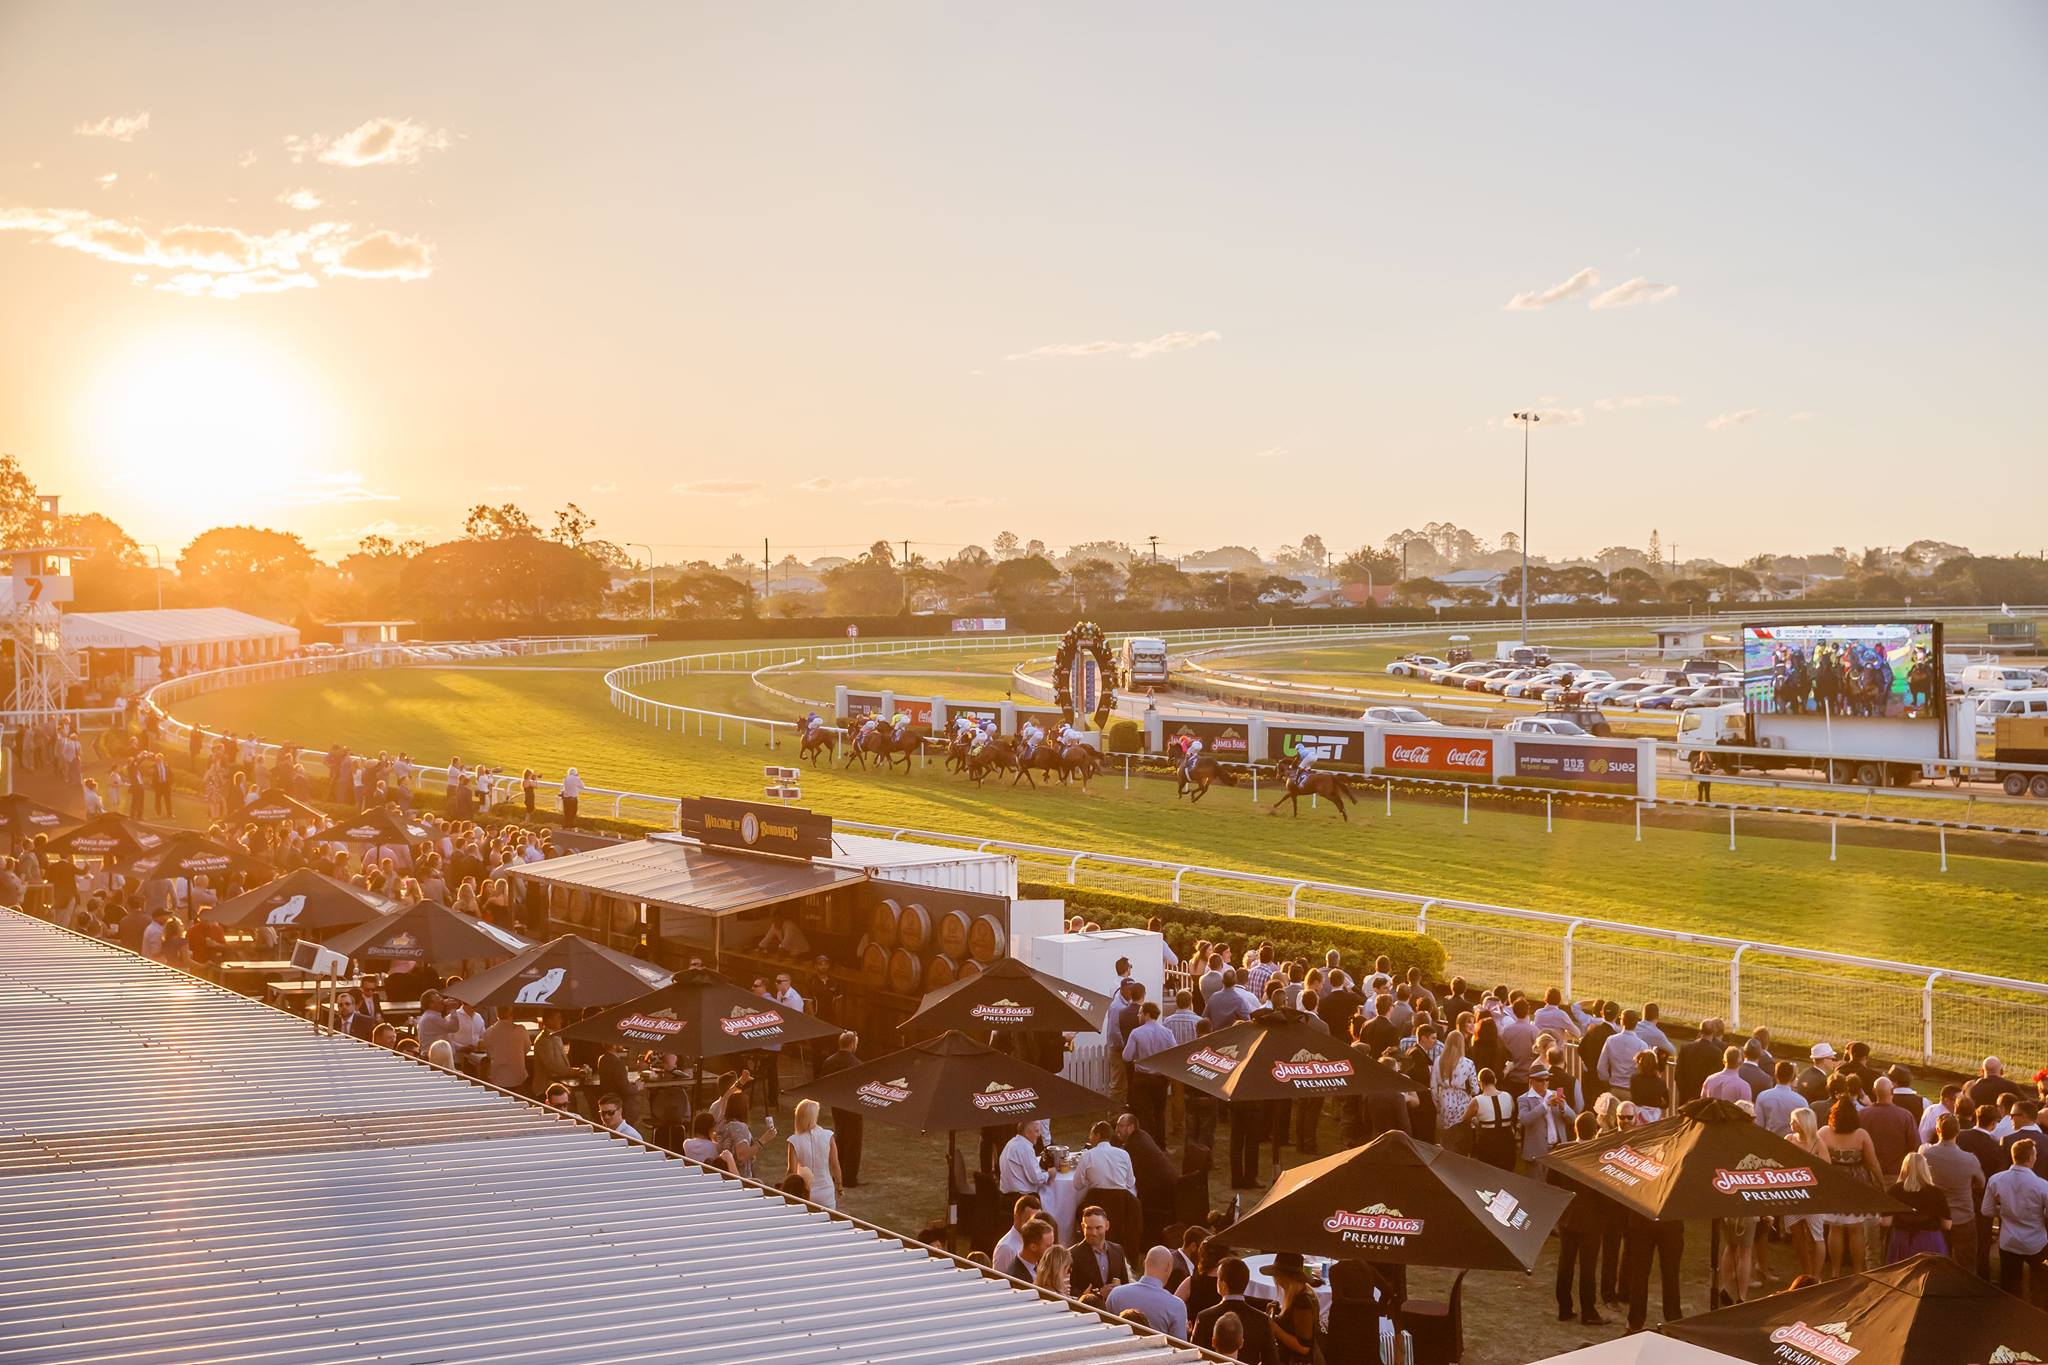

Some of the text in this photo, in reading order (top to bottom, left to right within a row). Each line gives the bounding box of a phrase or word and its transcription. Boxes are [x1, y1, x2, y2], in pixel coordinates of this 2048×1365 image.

[1392, 746, 1431, 764] Coca-Cola
[1446, 748, 1488, 767] Coca-Cola
[972, 1006, 1003, 1015] JAMES
[620, 1016, 656, 1028] JAMES
[724, 1018, 750, 1033] JAMES
[623, 1029, 666, 1042] PREMIUM
[741, 1026, 784, 1040] PREMIUM
[1274, 1064, 1312, 1078] JAMES
[1293, 1078, 1348, 1088] PREMIUM
[975, 1092, 1005, 1106] JAMES
[992, 1102, 1036, 1113] PREMIUM
[1604, 1148, 1639, 1166] JAMES
[1600, 1164, 1640, 1186] PREMIUM
[1717, 1171, 1764, 1189] JAMES
[1741, 1189, 1810, 1202] PREMIUM
[1327, 1214, 1420, 1231] JAMES BOAG'S
[1342, 1232, 1406, 1246] PREMIUM
[1776, 1324, 1820, 1348] JAMES
